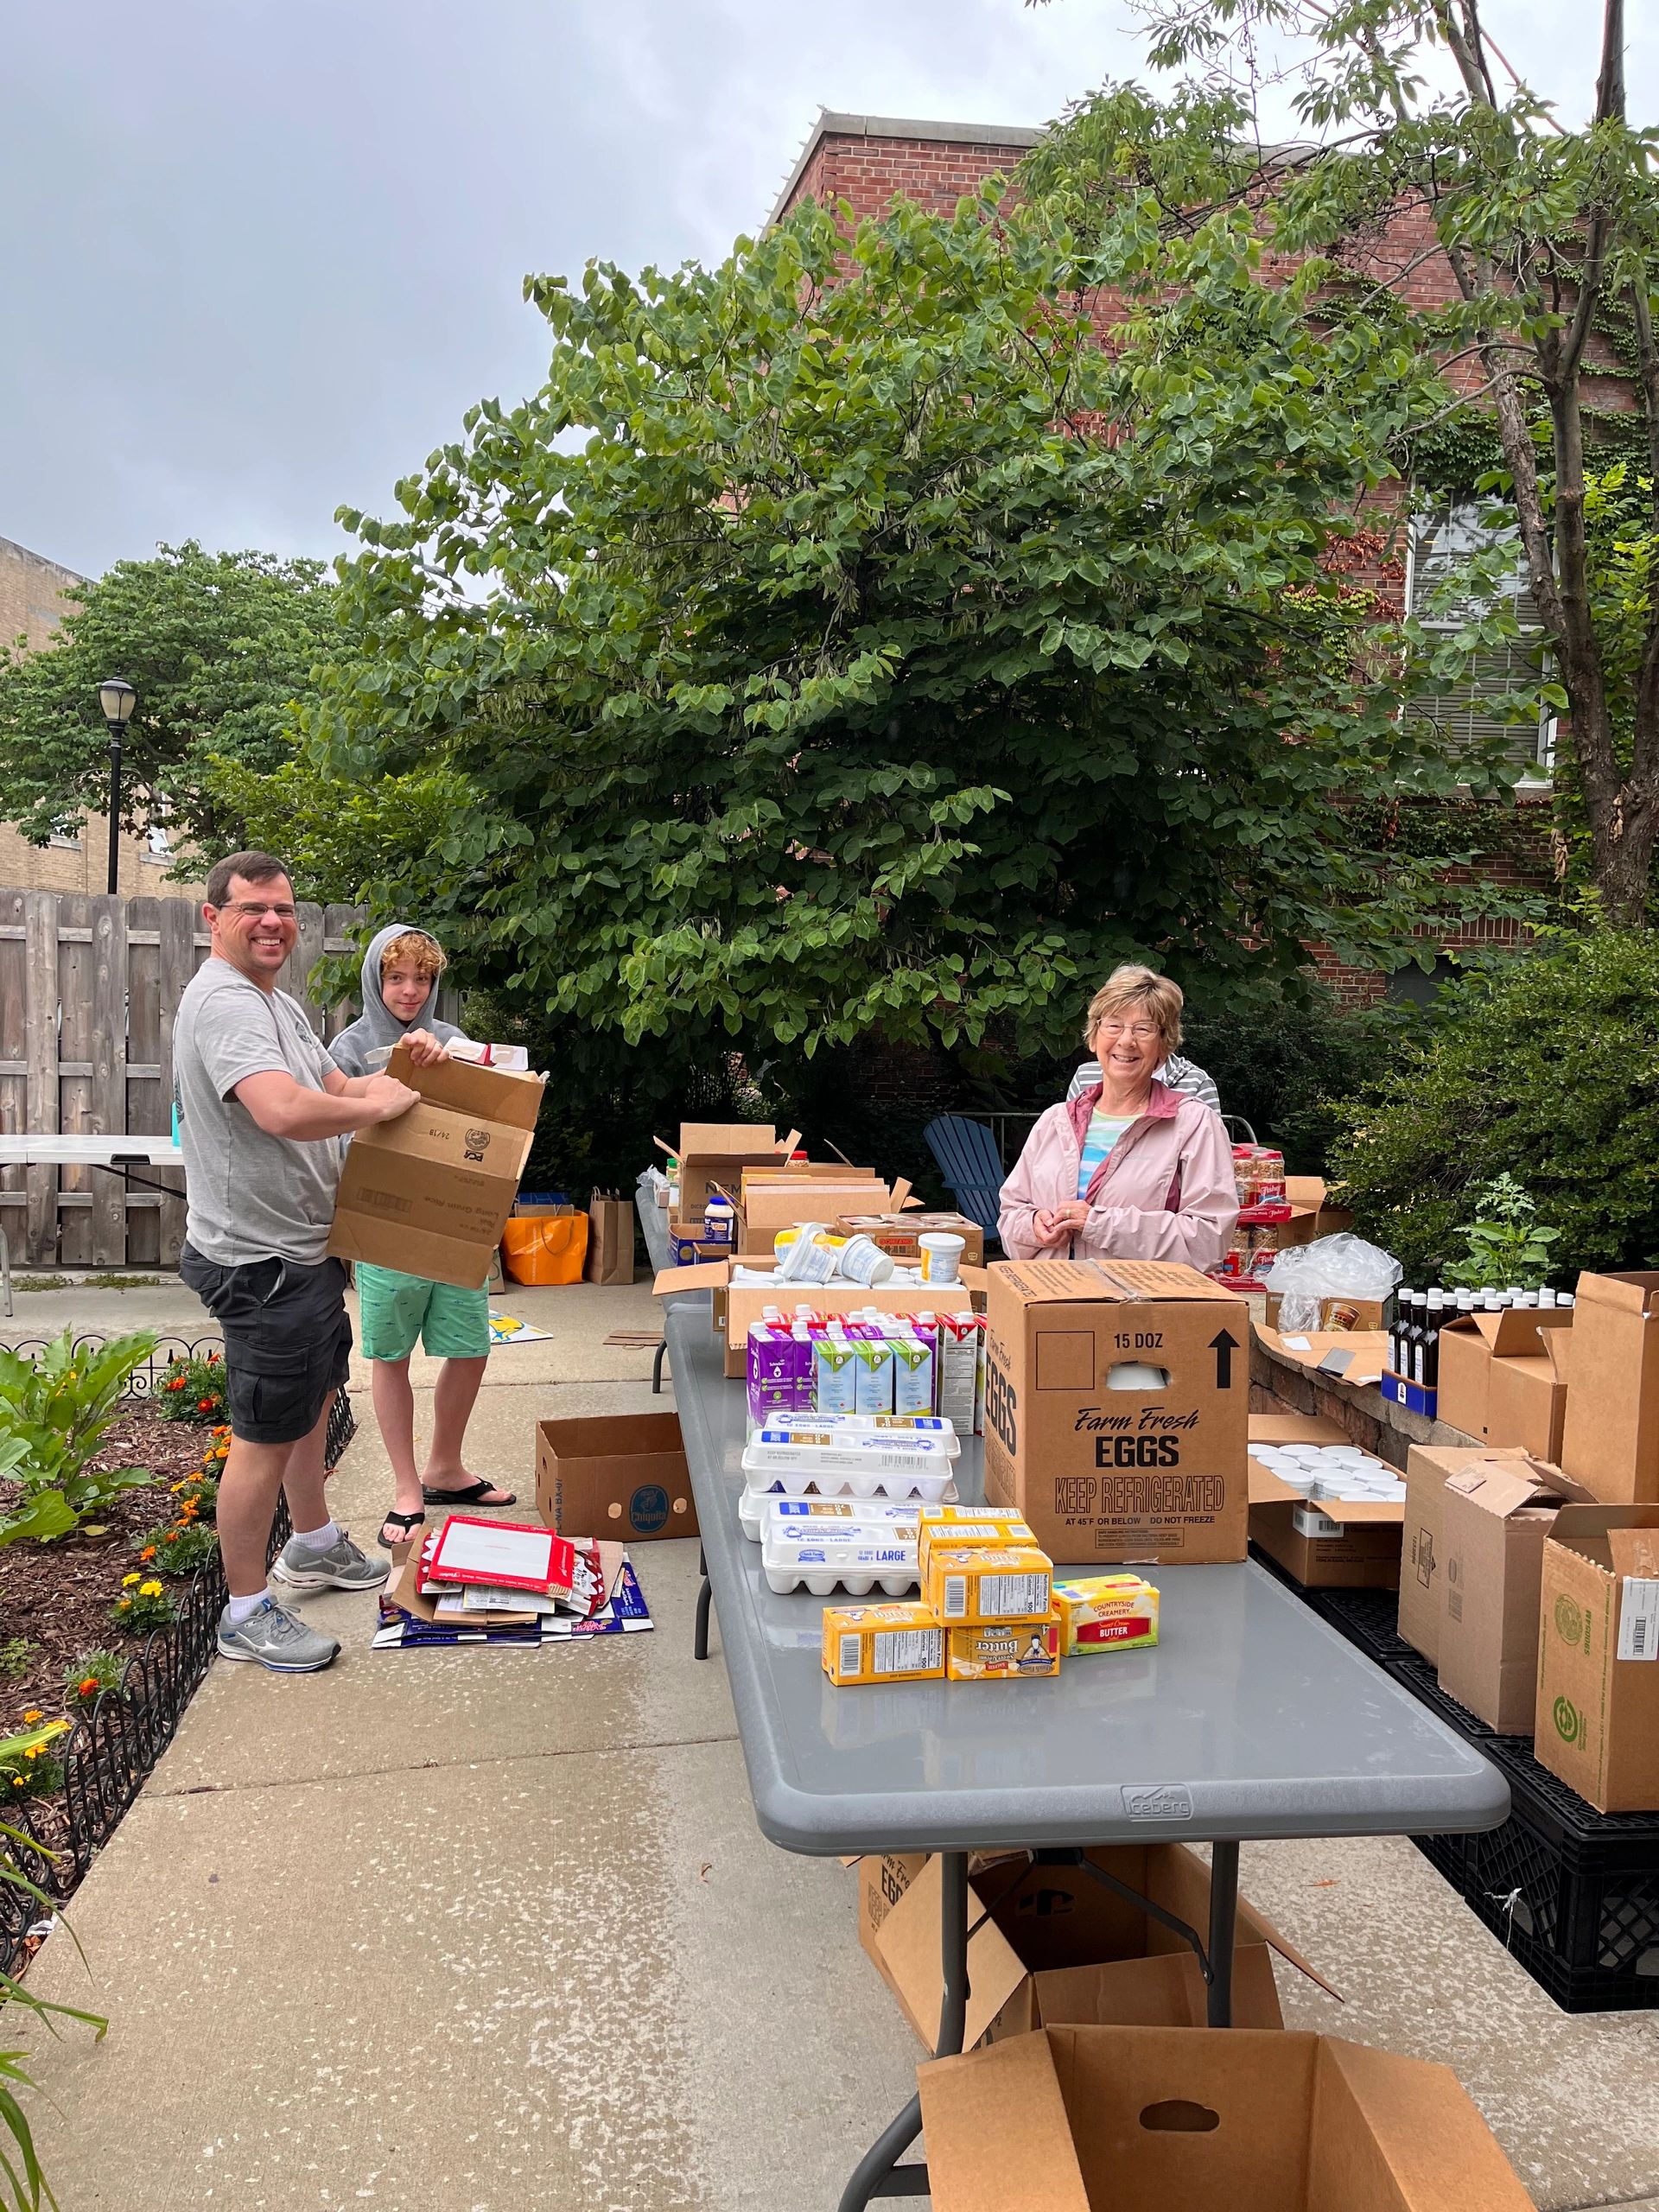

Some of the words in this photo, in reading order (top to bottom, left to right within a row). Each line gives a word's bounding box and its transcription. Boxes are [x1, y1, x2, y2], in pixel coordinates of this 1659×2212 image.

[464, 1149, 484, 1162] PCA
[1114, 1333, 1130, 1349] 15
[1135, 1332, 1163, 1348] DOZ
[986, 1351, 1017, 1457] EGGS
[1075, 1407, 1134, 1432] Farm
[1138, 1406, 1200, 1430] Fresh
[1095, 1434, 1179, 1468] EGGS
[1055, 1477, 1097, 1514] KEEP
[1101, 1475, 1225, 1514] REFRIGERATED
[632, 1510, 667, 1525] Chiquita
[1111, 1516, 1141, 1525] BELOW
[1183, 1516, 1216, 1524] FREEZE
[876, 1550, 906, 1561] LARGE
[1093, 1600, 1135, 1612] COUNTRYSIDE
[1098, 1609, 1130, 1618] CREAMERY
[1099, 1626, 1128, 1638] BUTTER
[976, 1639, 1019, 1654] Butter
[1127, 1798, 1191, 1817] iceberg
[881, 1864, 904, 1907] EG
